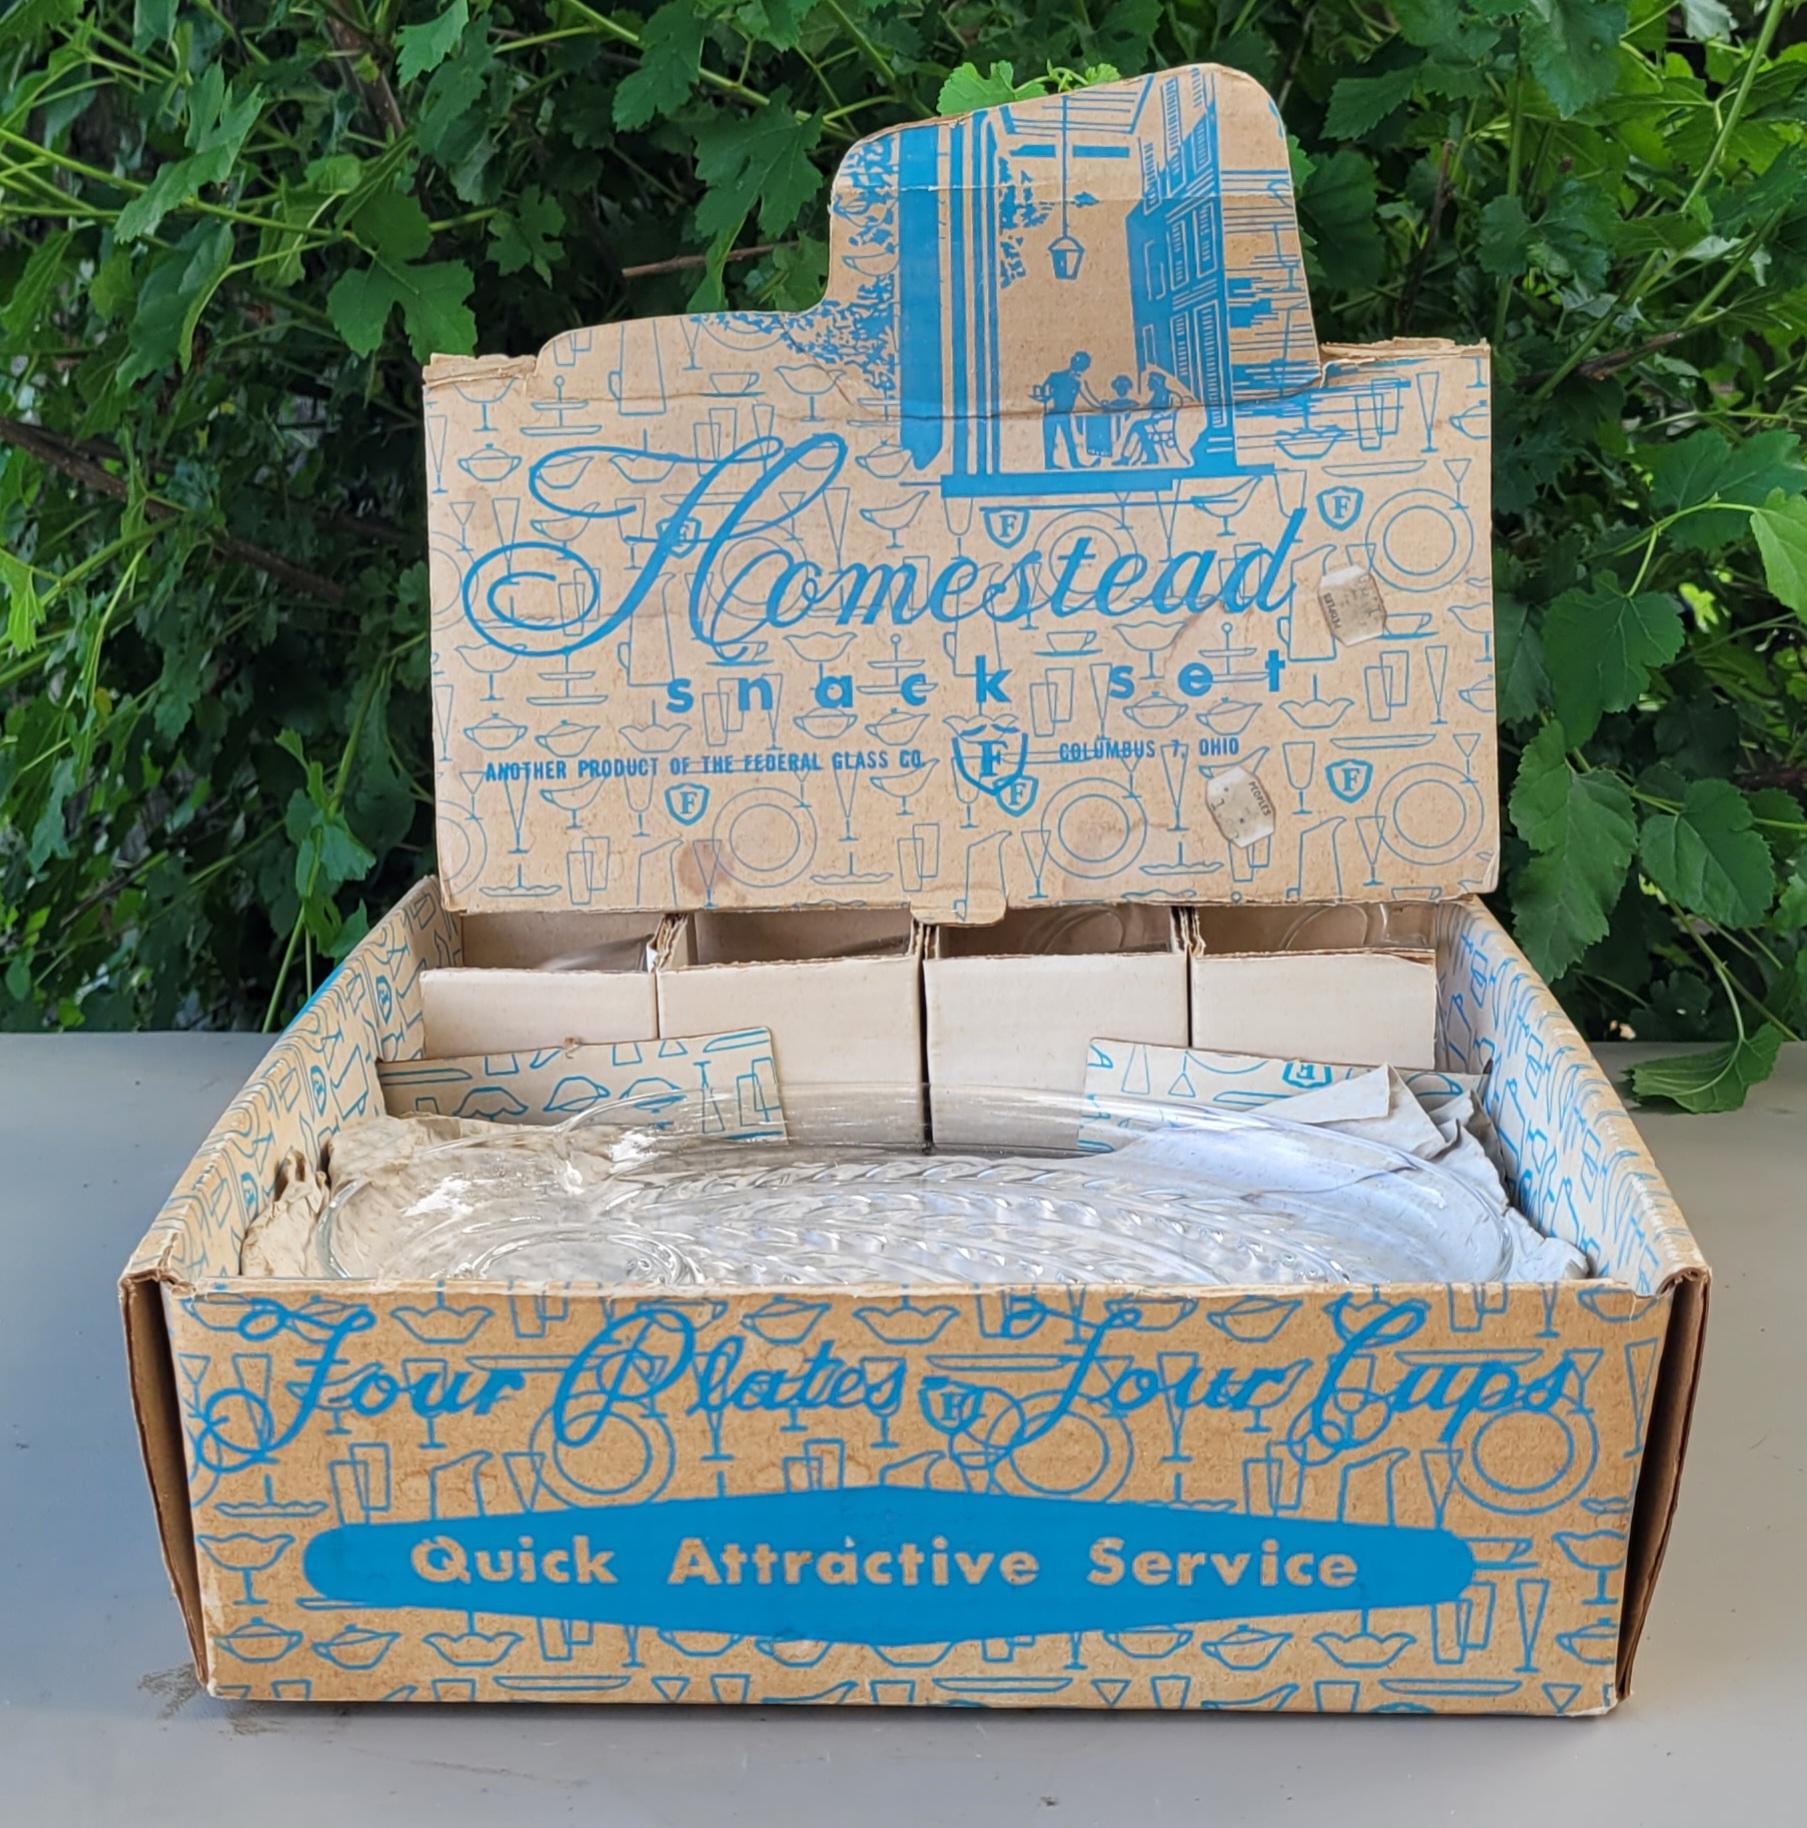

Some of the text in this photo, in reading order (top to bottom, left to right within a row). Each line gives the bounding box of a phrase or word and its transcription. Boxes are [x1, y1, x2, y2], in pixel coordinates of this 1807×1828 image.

[1331, 494, 1352, 519] F
[999, 514, 1017, 538] F
[462, 432, 1307, 660] Homestead
[665, 649, 1286, 714] snack set
[976, 739, 1009, 777] F
[1058, 739, 1156, 762] COLUMBUS
[1198, 737, 1240, 757] OHIO
[484, 758, 568, 782] ANOTHER
[577, 756, 659, 779] PRODUCT
[669, 756, 692, 775] OF
[702, 754, 734, 774] THE
[743, 752, 824, 772] FEDERAL
[831, 750, 889, 771] GLASS
[1341, 767, 1360, 793] F
[679, 791, 698, 815] F
[1008, 780, 1027, 807] F
[1248, 781, 1272, 817] PEOPLES
[195, 1291, 1576, 1473] Four Plates Four Cups
[410, 1534, 1358, 1588] Quick Attractive Service
